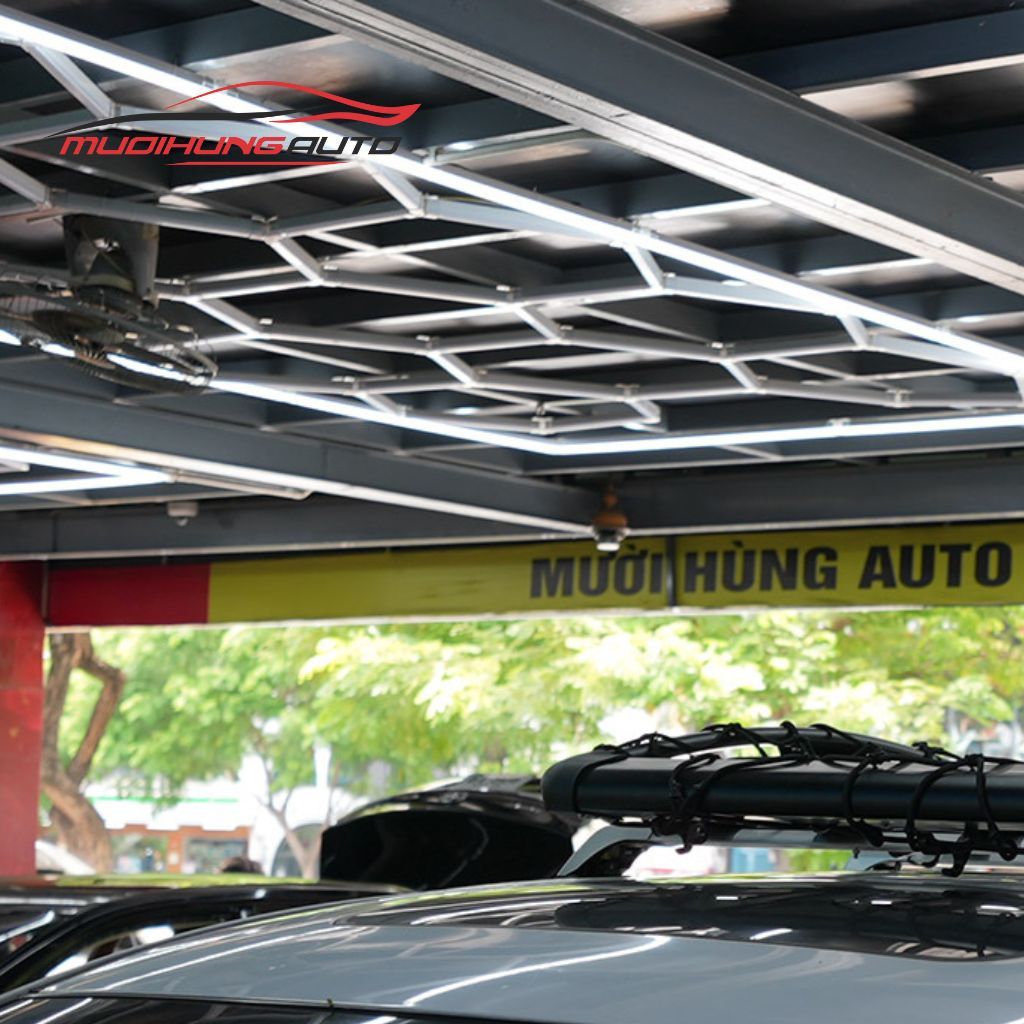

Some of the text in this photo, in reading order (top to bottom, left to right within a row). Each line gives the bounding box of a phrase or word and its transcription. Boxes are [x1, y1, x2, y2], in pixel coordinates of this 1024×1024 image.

[531, 543, 663, 598] MƯỜI
[684, 541, 838, 592] HÙNG
[858, 541, 1012, 588] AUTO
